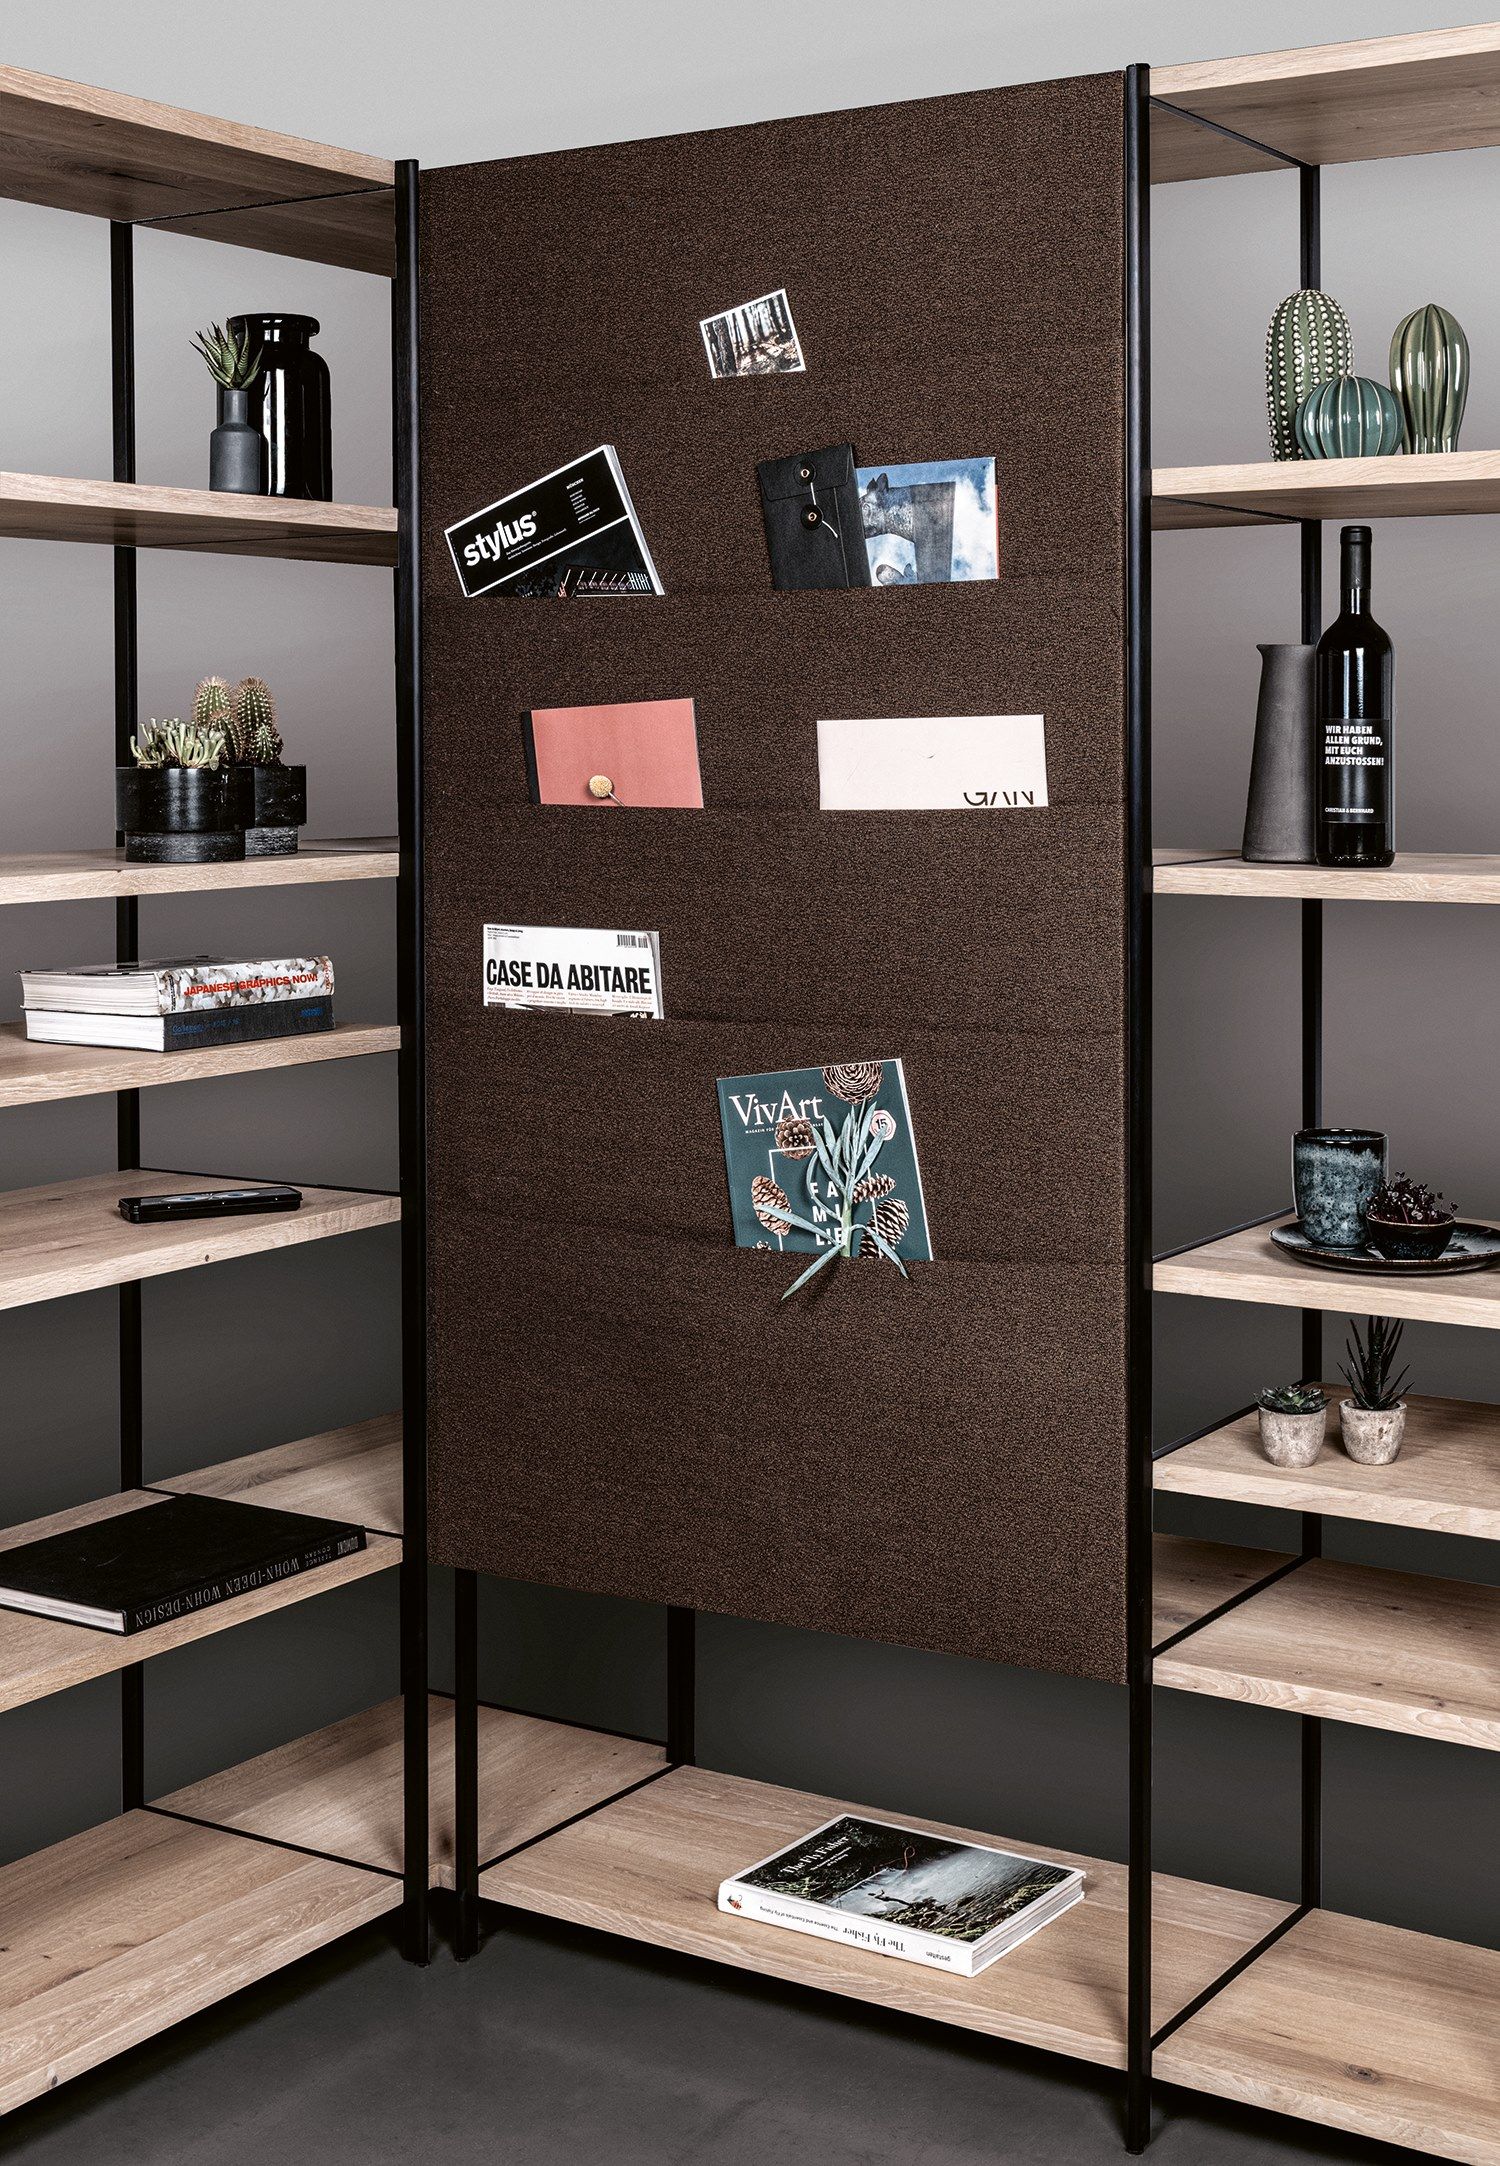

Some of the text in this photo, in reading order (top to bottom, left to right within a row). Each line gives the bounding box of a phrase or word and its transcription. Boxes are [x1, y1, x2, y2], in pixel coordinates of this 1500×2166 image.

[1325, 725, 1373, 735] WIR HABEN
[1325, 736, 1383, 746] ALLEN GRUND,
[1325, 746, 1364, 756] MIT EUCH
[1325, 757, 1385, 766] ANZUSTOSSEN!
[183, 973, 319, 997] JAPANESE GRAPHICS NOW!
[486, 958, 653, 995] CASE DA ABITARE
[729, 1089, 825, 1127] VivArt
[136, 1557, 300, 1628] WOHN-IDEEN WOHN-DESIGN
[843, 1926, 906, 1953] The Fly Fisher
